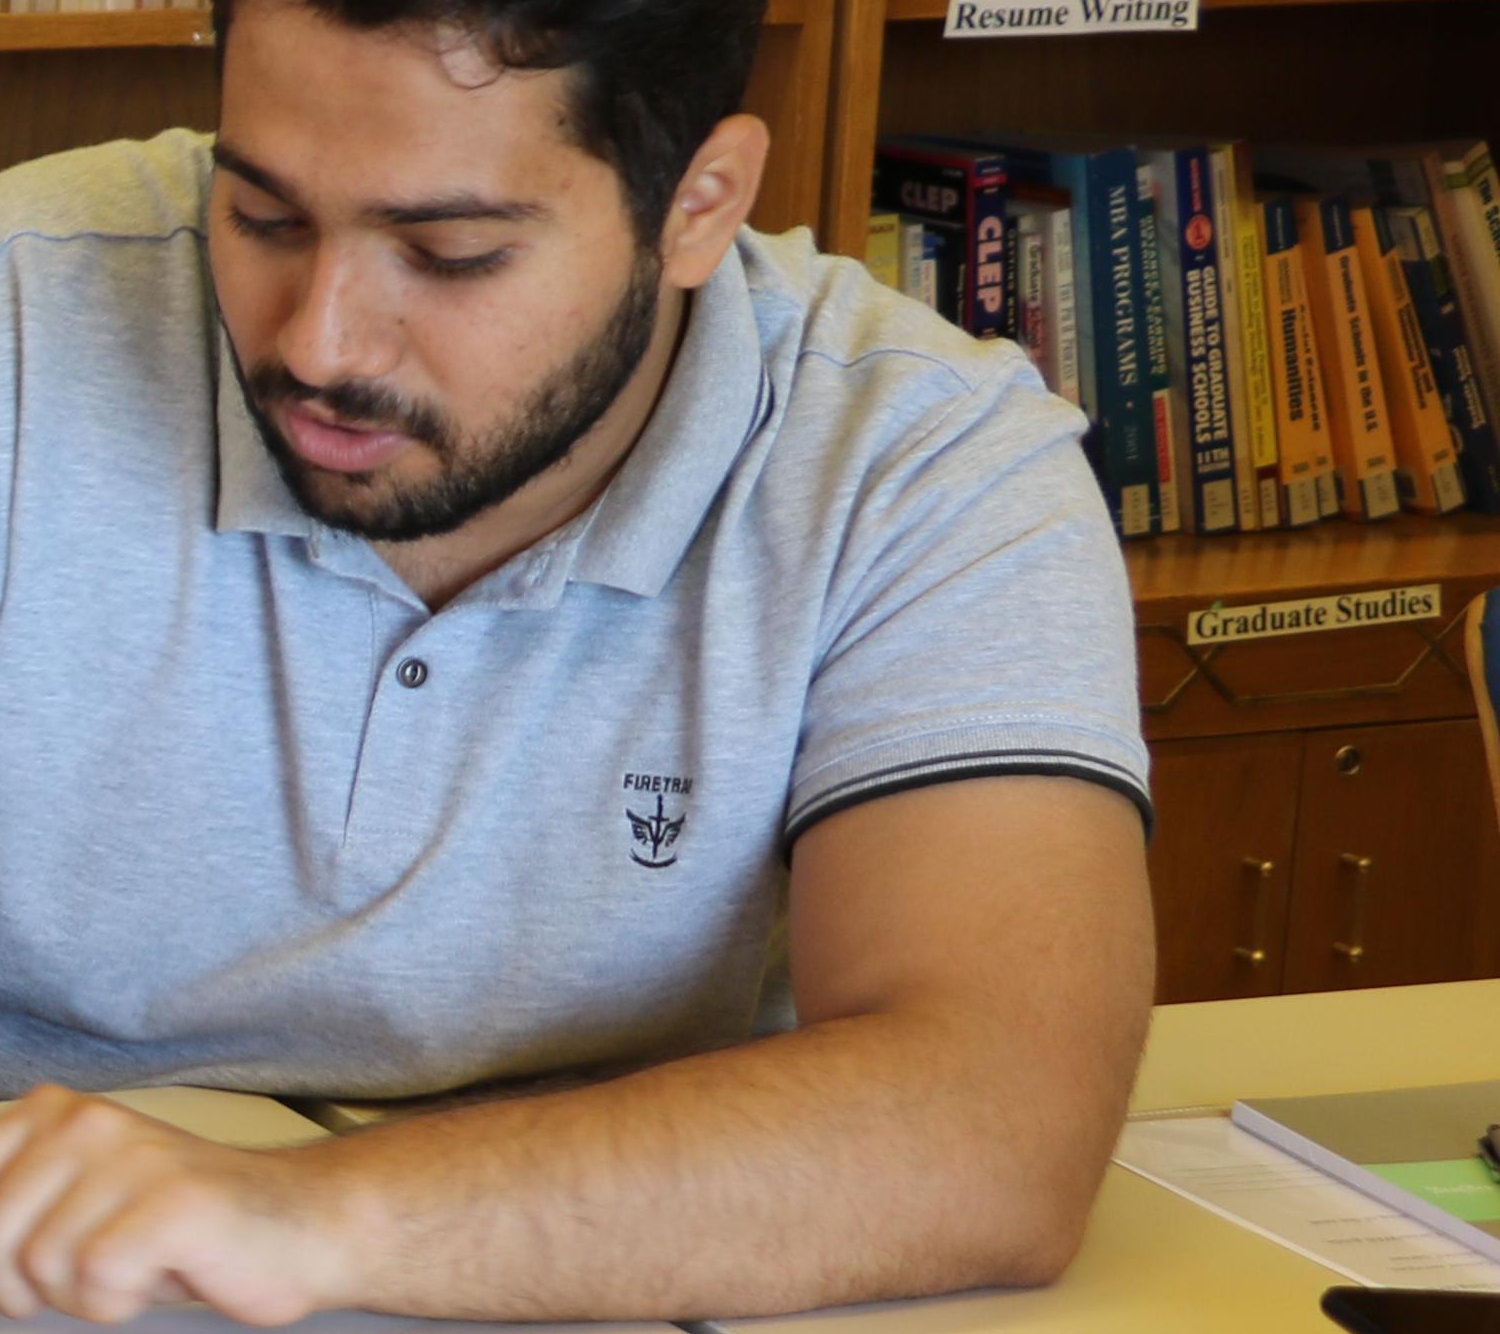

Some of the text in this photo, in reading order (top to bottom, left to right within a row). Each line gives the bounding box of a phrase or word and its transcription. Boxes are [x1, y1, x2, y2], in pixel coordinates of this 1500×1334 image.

[954, 3, 1068, 29] Resume
[902, 183, 959, 213] CLEP
[977, 216, 1004, 314] CLEP
[1109, 187, 1138, 385] MBA PROGRAMS
[1186, 270, 1210, 442] BUSINESS SCHOOLS
[1200, 266, 1227, 438] GUIDE TO GRADUATE
[1282, 307, 1304, 422] Humanities
[1195, 590, 1433, 638] Graduate Studies
